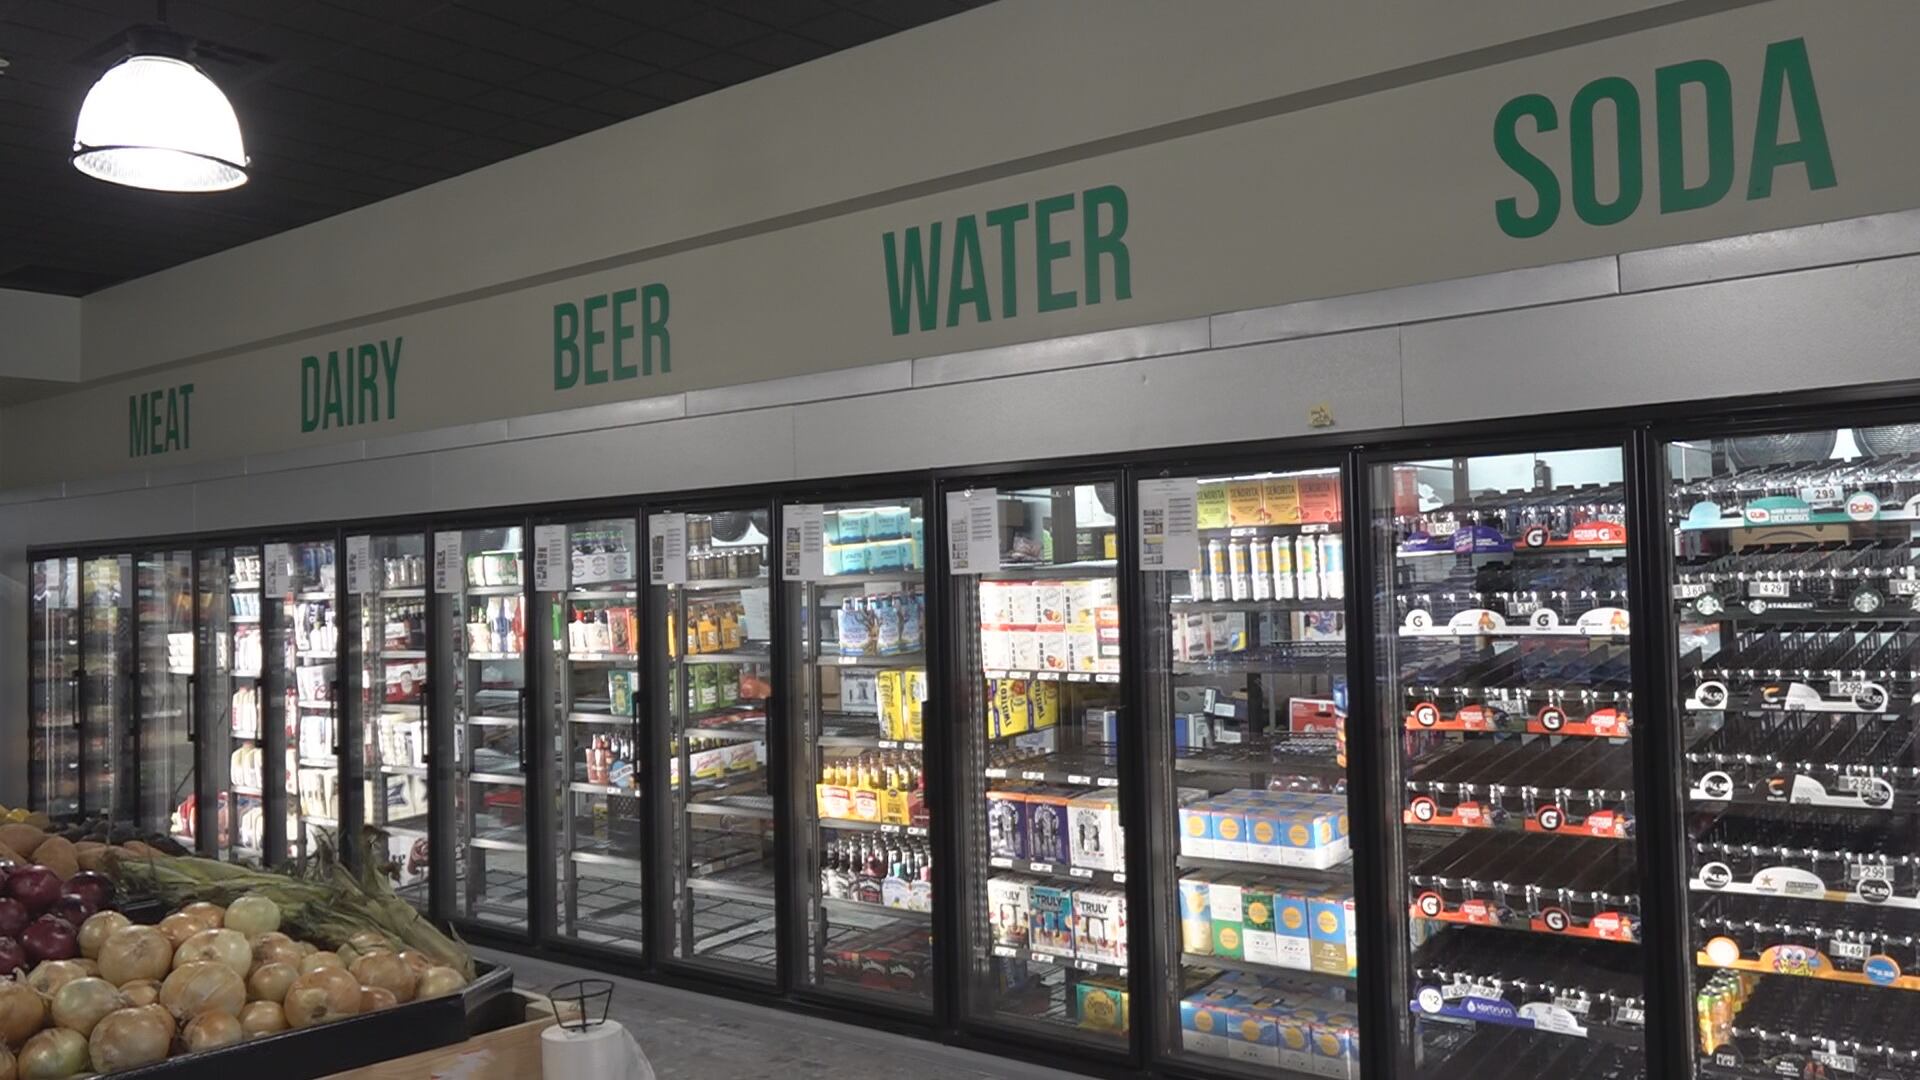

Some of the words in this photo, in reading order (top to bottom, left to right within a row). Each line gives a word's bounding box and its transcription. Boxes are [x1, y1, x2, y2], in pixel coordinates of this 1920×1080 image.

[1493, 37, 1837, 239] SODA
[882, 185, 1132, 335] WATER
[553, 283, 671, 391] BEER
[301, 336, 403, 433] DAIRY
[129, 383, 194, 458] MEAT
[1851, 503, 1874, 513] Dole
[1528, 529, 1544, 546] G
[1598, 528, 1610, 540] G
[1413, 615, 1423, 627] G
[1537, 614, 1549, 626] G
[1001, 688, 1012, 728] TWISTED
[1419, 707, 1434, 725] G
[1543, 712, 1560, 729] G
[1416, 801, 1431, 818] G
[1541, 811, 1557, 829] G
[1036, 894, 1063, 907] TRULY
[1081, 901, 1108, 914] TRULY
[1422, 896, 1437, 914] G
[1547, 911, 1563, 929] G
